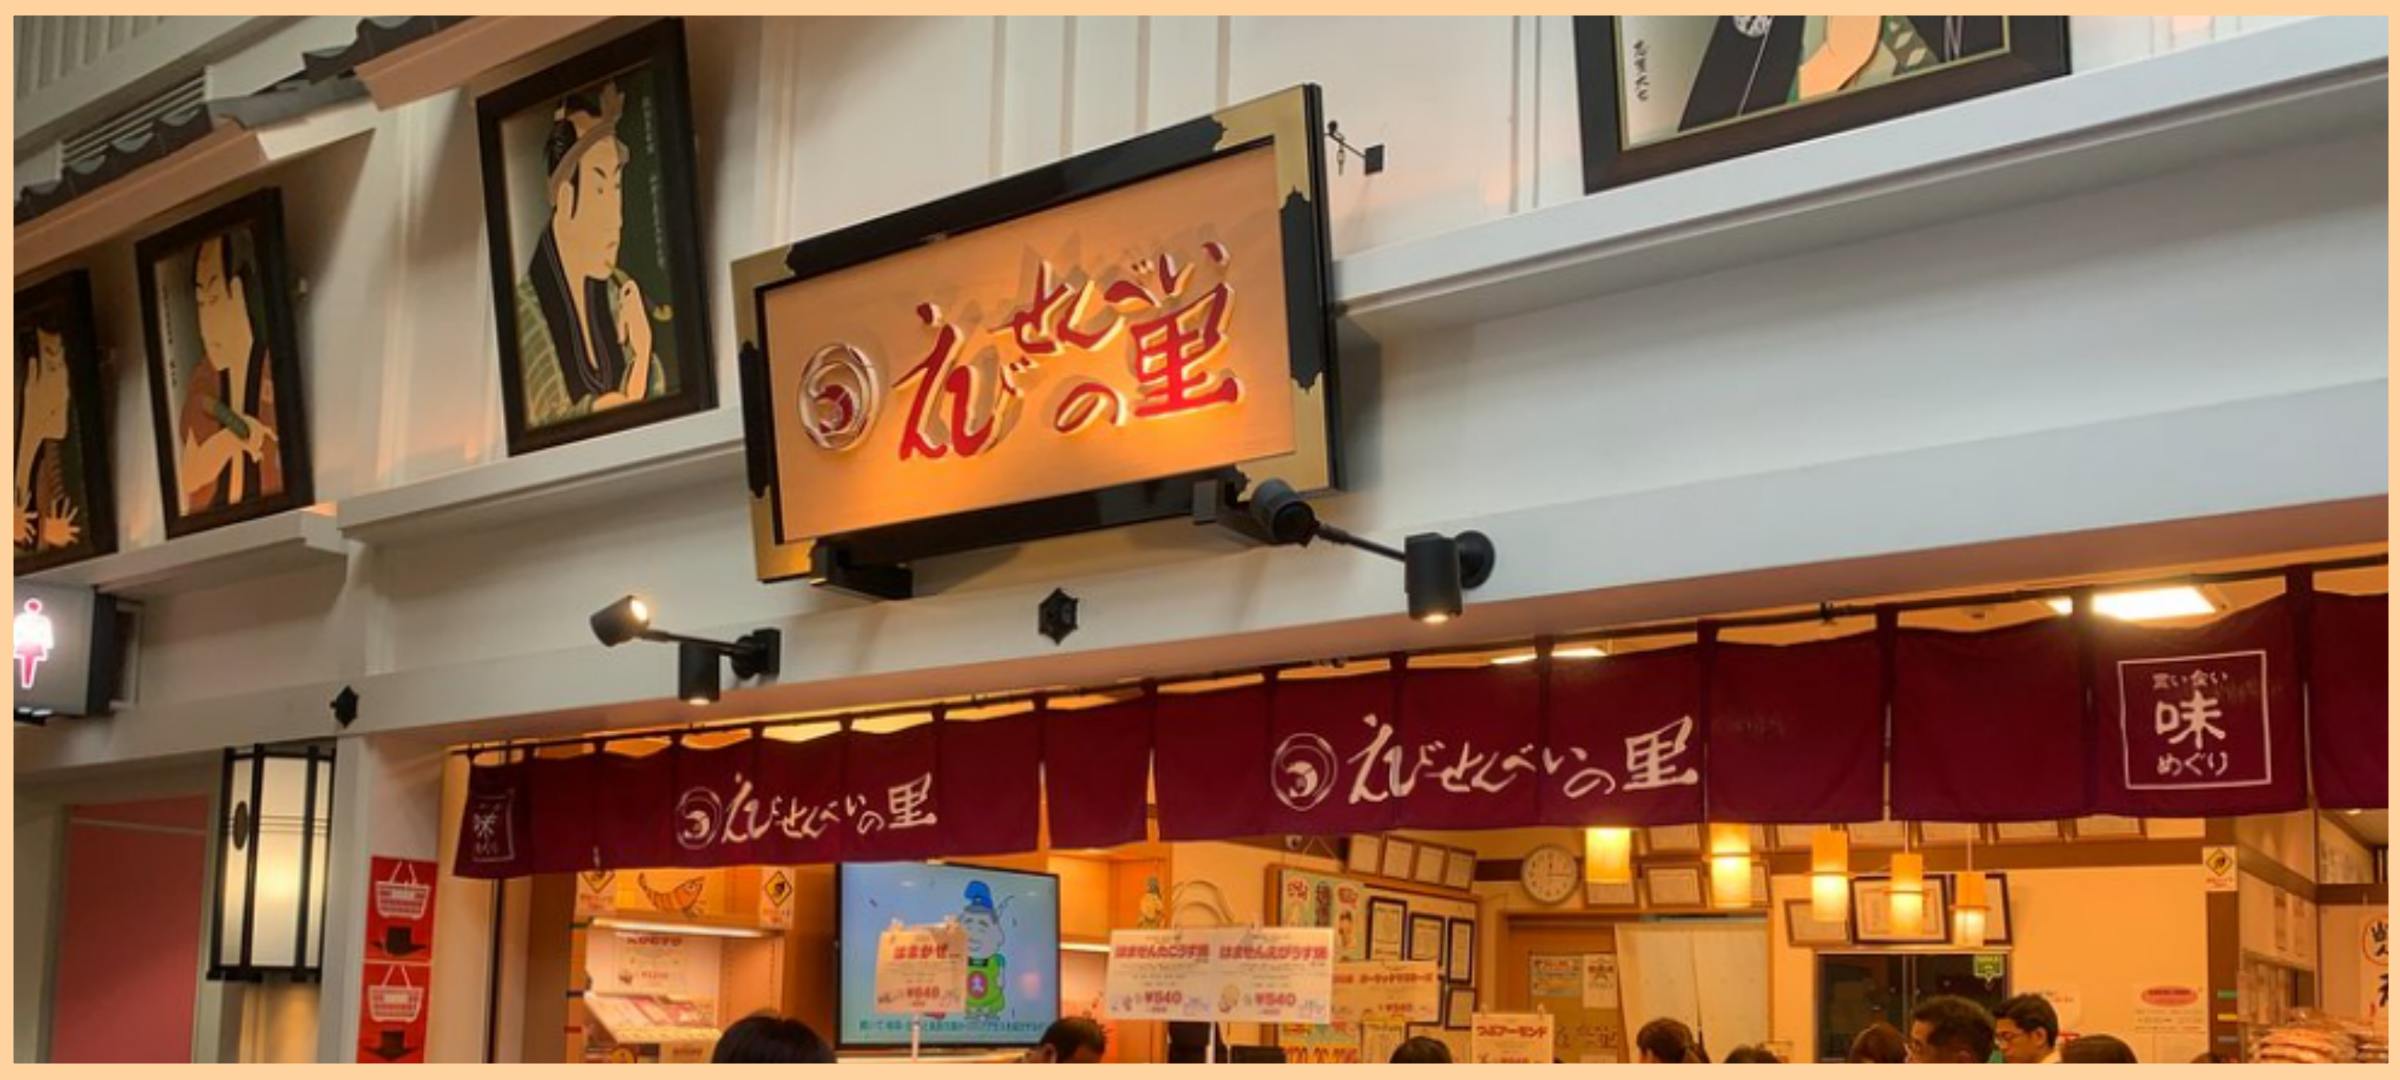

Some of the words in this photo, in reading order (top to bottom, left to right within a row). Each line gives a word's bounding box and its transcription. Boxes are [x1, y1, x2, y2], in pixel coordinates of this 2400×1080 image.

[893, 241, 1243, 460] えびせんべいの里
[2155, 690, 2226, 749] 味
[1347, 713, 1699, 804] えびせんべいの里
[2157, 751, 2228, 776] めぐり
[721, 770, 937, 843] えびせんべいの里
